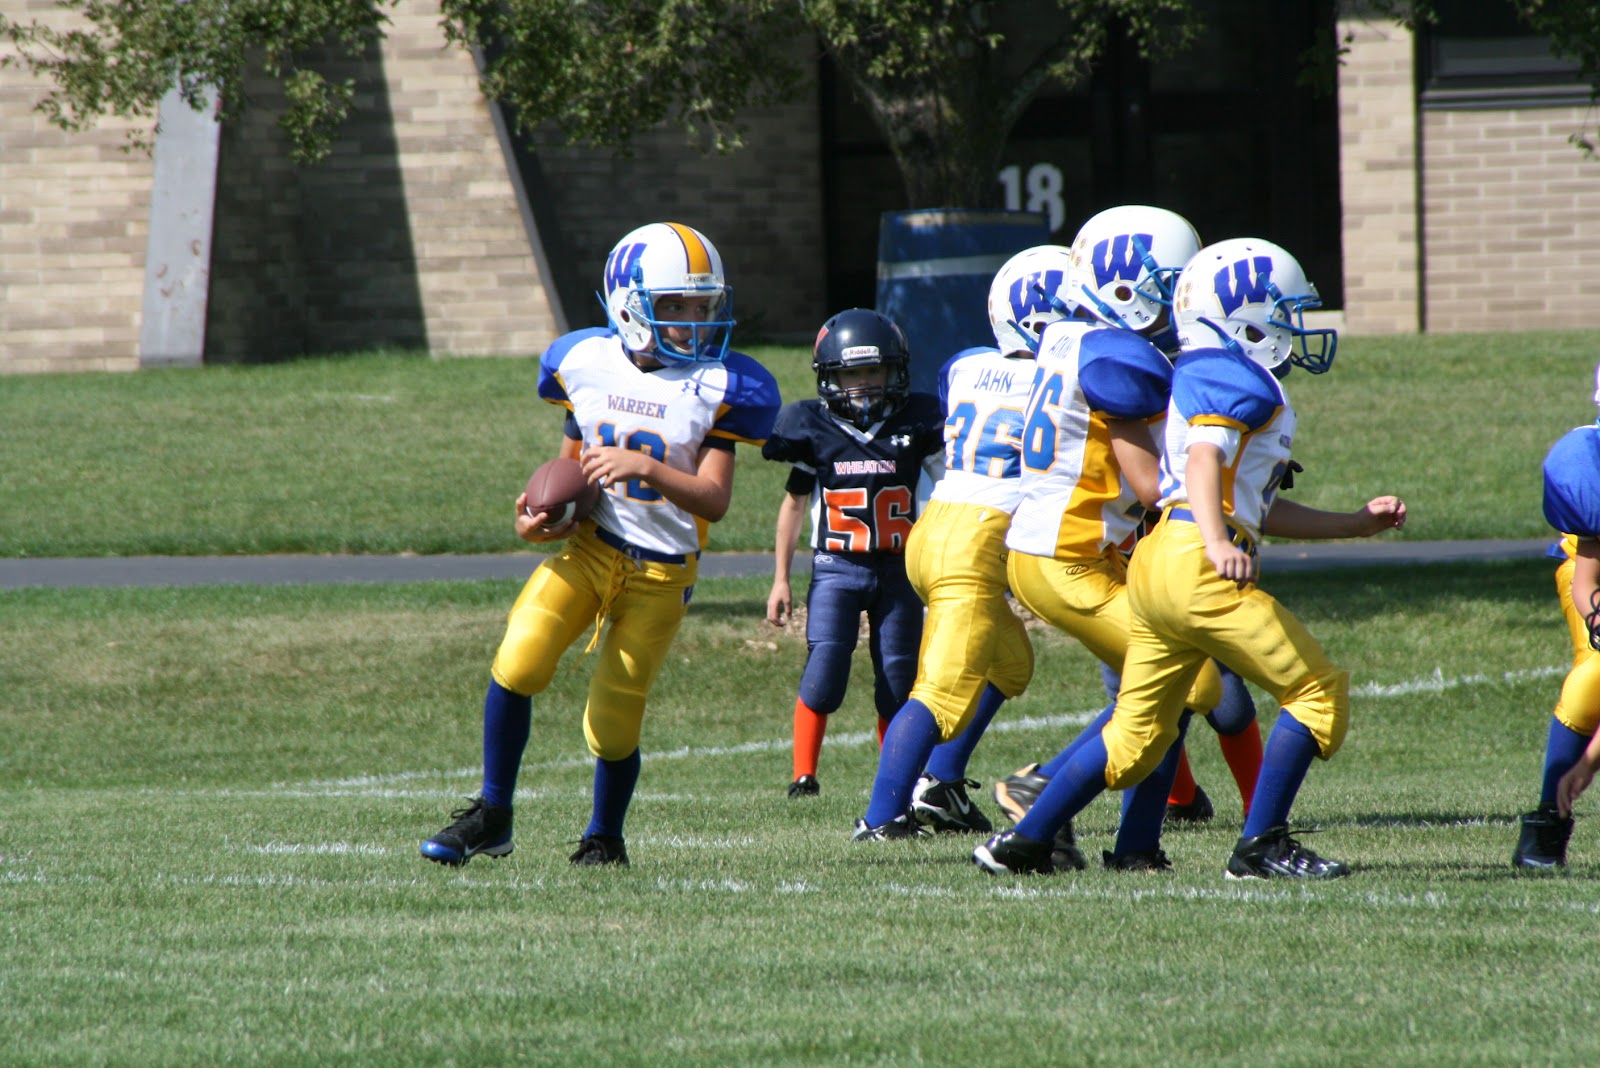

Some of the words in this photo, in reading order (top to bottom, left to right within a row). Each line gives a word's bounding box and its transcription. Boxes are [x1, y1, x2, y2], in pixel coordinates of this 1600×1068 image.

[998, 163, 1064, 233] 18
[606, 243, 648, 298] W
[1089, 233, 1153, 290] W
[1213, 255, 1273, 319] W
[607, 394, 668, 420] WARREN
[973, 367, 1016, 394] JAHN
[833, 460, 897, 476] WHEATON
[823, 485, 914, 553] 56
